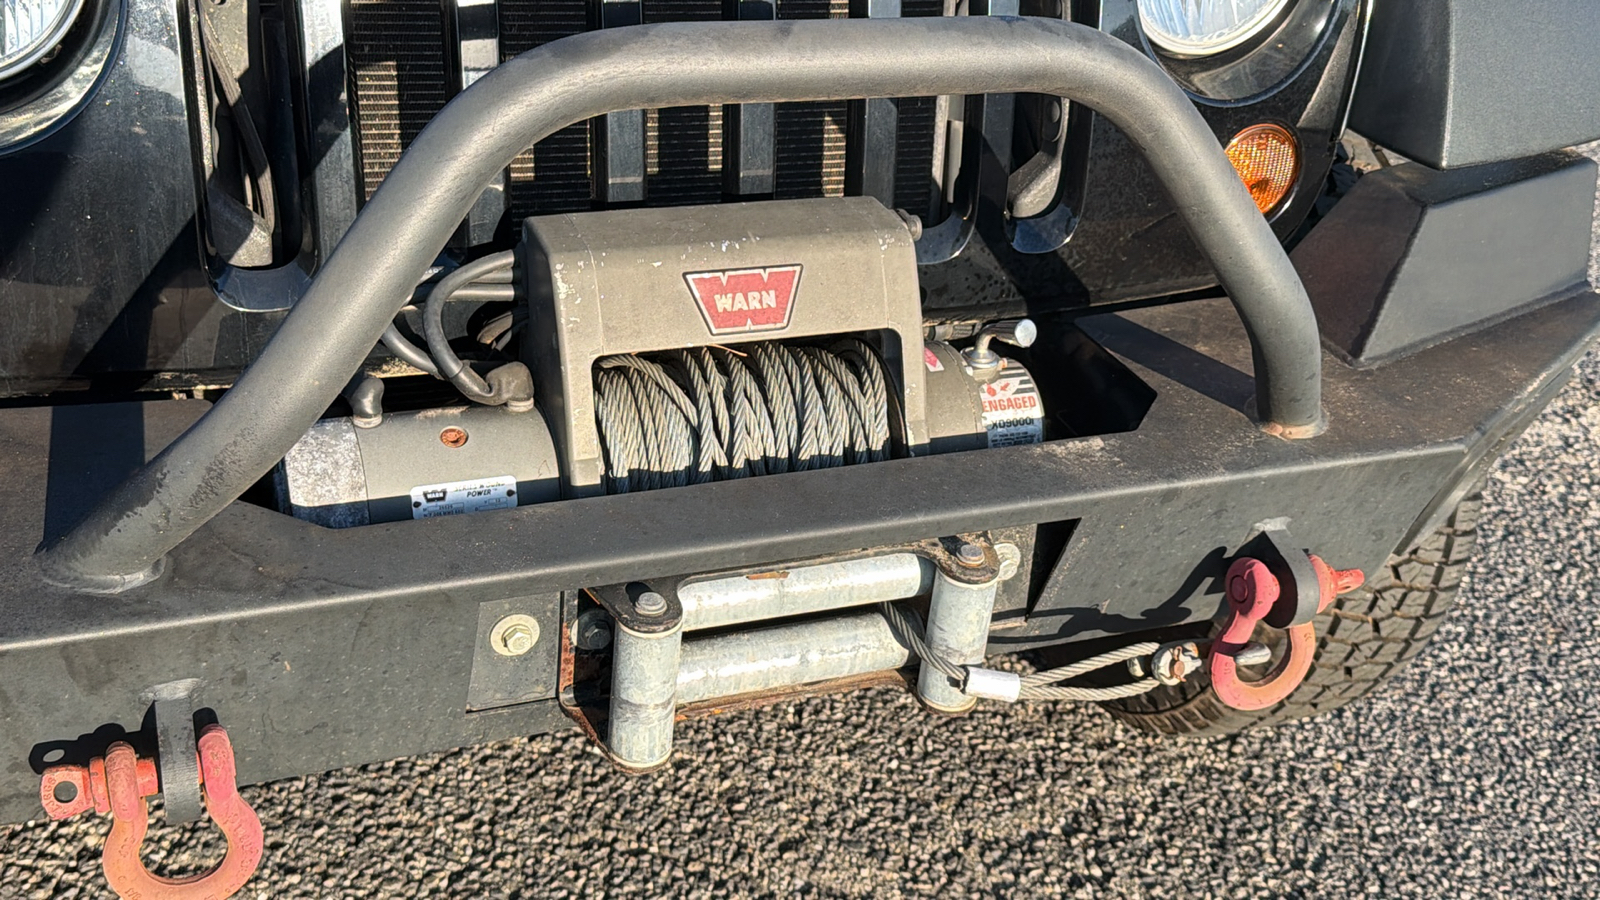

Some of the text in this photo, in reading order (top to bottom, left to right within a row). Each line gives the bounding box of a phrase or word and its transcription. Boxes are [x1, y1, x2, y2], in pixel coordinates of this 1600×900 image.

[714, 290, 776, 312] WARN
[982, 396, 1036, 413] ENGAGED
[466, 489, 491, 498] POWER
